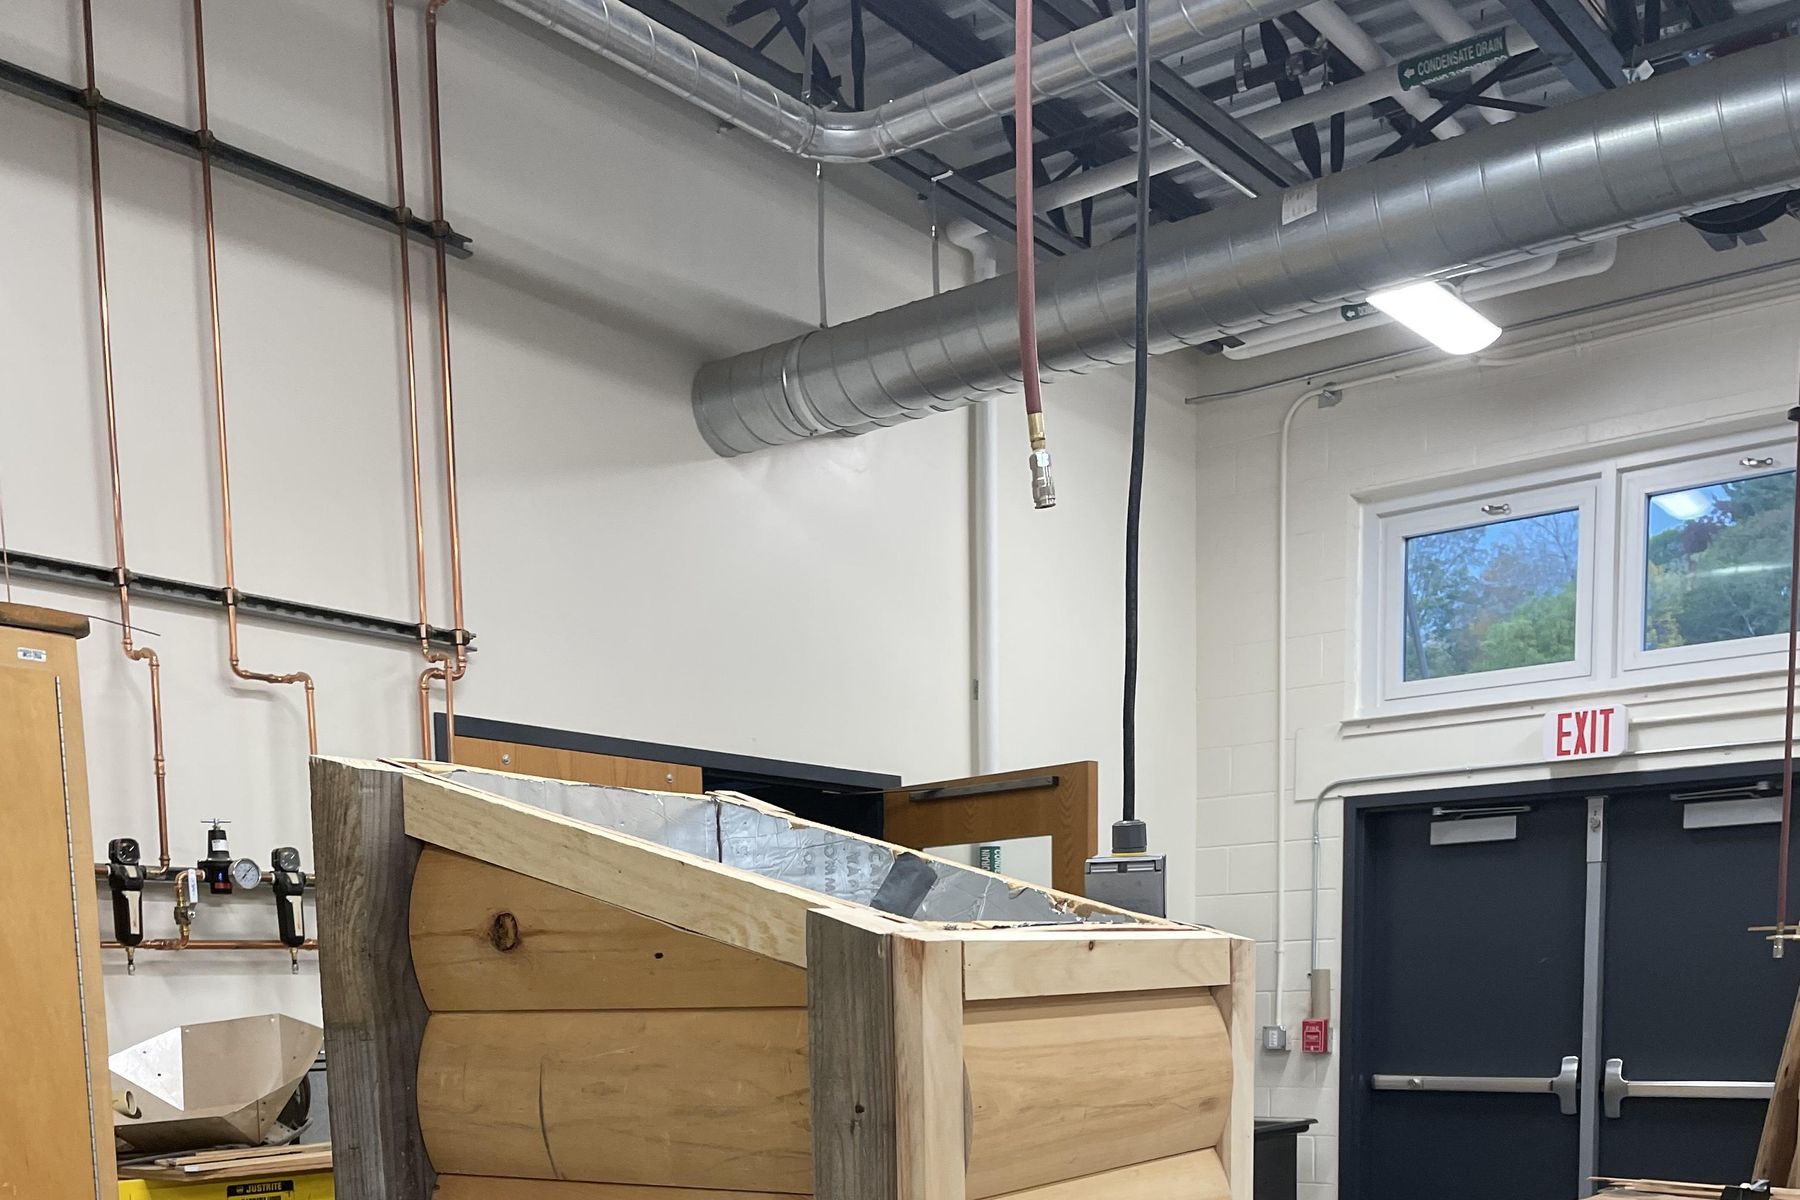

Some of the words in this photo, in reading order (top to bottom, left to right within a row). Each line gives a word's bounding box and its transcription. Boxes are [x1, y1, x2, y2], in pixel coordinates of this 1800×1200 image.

[1417, 45, 1475, 76] CONDENSATE
[1475, 36, 1504, 57] DRAIN
[1557, 708, 1615, 756] EXIT
[246, 1182, 282, 1194] JUSTRITE
